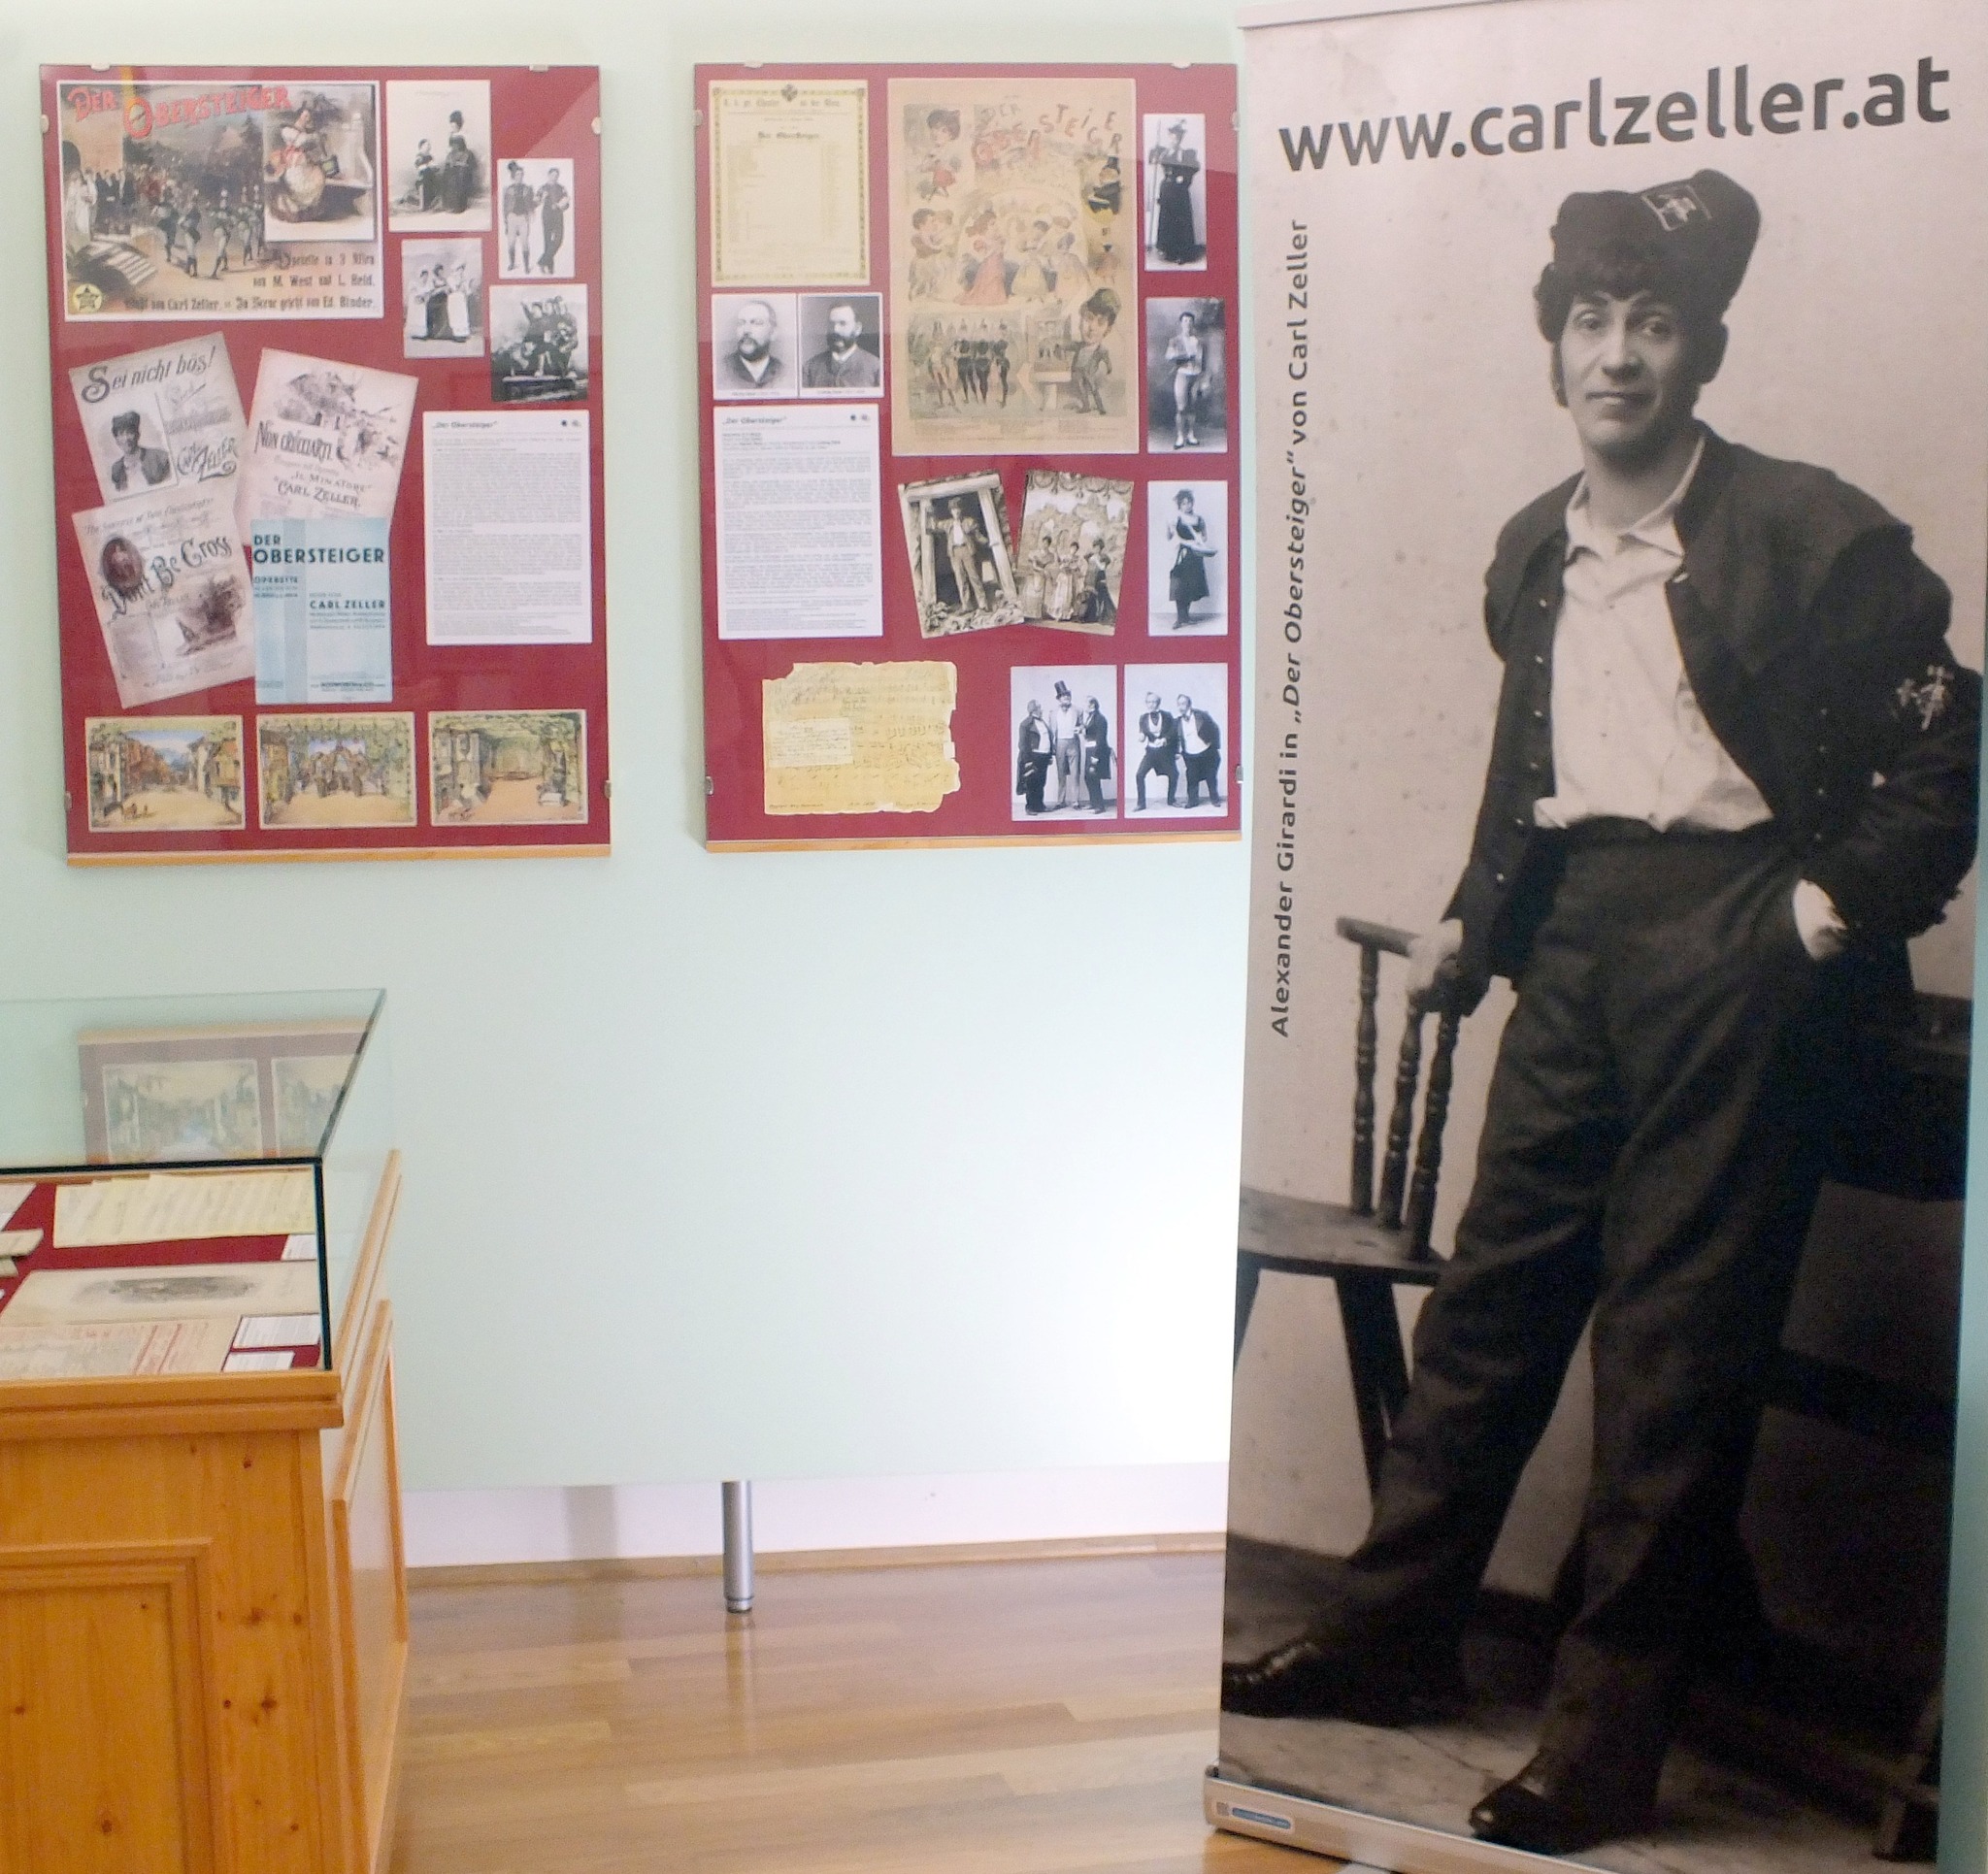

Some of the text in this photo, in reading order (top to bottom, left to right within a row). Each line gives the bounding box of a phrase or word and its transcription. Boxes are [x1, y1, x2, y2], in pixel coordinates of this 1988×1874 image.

[1278, 56, 1950, 171] www.carlzeller.at
[1286, 219, 1309, 309] Zeller
[1287, 318, 1309, 380] Carl
[81, 366, 127, 404] Sei
[131, 359, 173, 386] nicht
[1291, 390, 1308, 445] von
[253, 534, 281, 546] DER
[253, 547, 384, 564] OBERSTEIGER
[1279, 733, 1298, 759] in
[1276, 770, 1298, 871] Girardi
[1272, 881, 1293, 1037] Alexander
